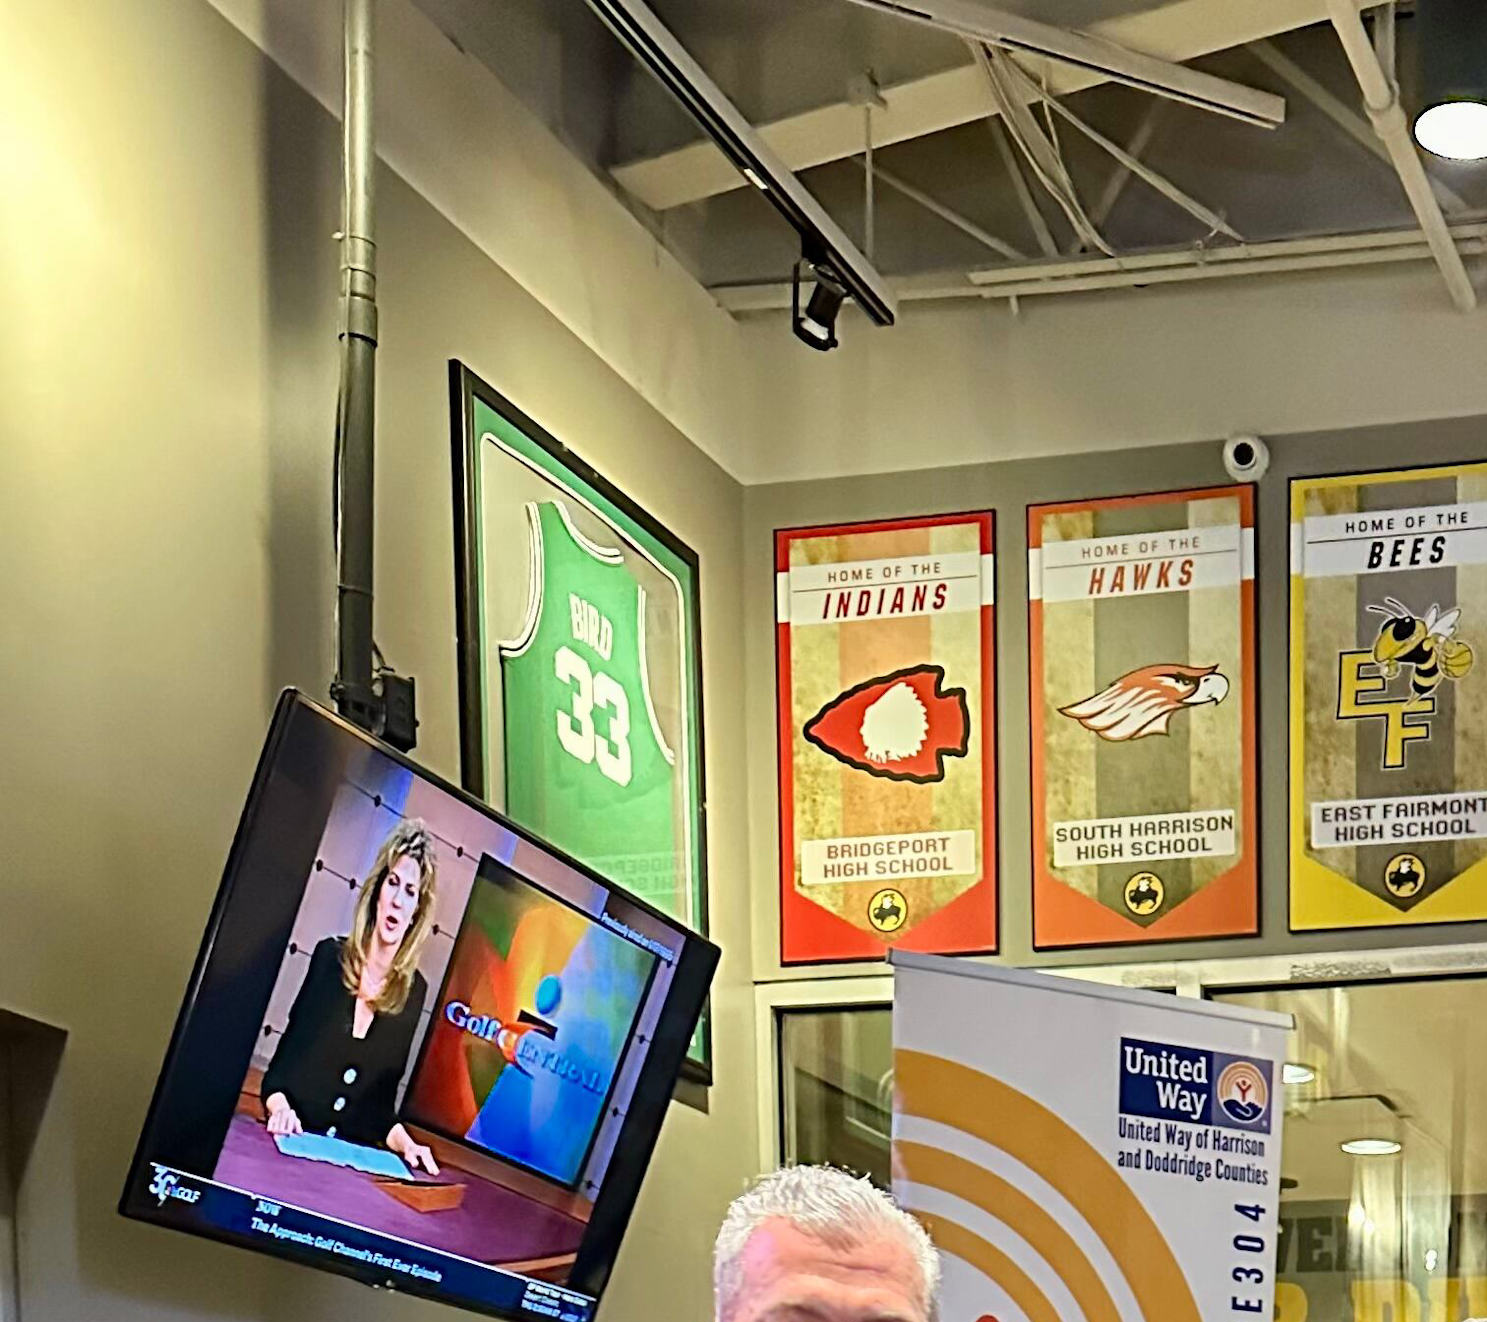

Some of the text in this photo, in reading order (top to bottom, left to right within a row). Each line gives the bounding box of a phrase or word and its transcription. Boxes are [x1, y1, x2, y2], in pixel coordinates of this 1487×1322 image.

[1345, 511, 1468, 534] HOME OF THE
[1081, 536, 1200, 559] HOME OF THE
[1367, 536, 1446, 570] BEES
[827, 562, 941, 583] HOME OF THE
[1088, 558, 1195, 596] HAWKS
[822, 583, 948, 620] INDIANS
[568, 591, 613, 662] BIRD
[554, 645, 634, 788] 33
[1056, 814, 1233, 842] SOUTH HARRISON
[1321, 805, 1376, 823] EAST
[1335, 819, 1477, 842] HIGH SCHOOL
[823, 852, 953, 878] HIGH SCHOOL
[827, 836, 951, 861] BRIDGEPORT
[1076, 837, 1213, 860] HIGH SCHOOL
[444, 1000, 503, 1042] Golf
[1124, 1045, 1209, 1084] United
[1156, 1081, 1208, 1120] Way
[1118, 1116, 1266, 1158] United Way of Harrison
[1117, 1148, 1269, 1186] and Doddridge Counties
[250, 1216, 271, 1233] The
[315, 1235, 334, 1252] Golf
